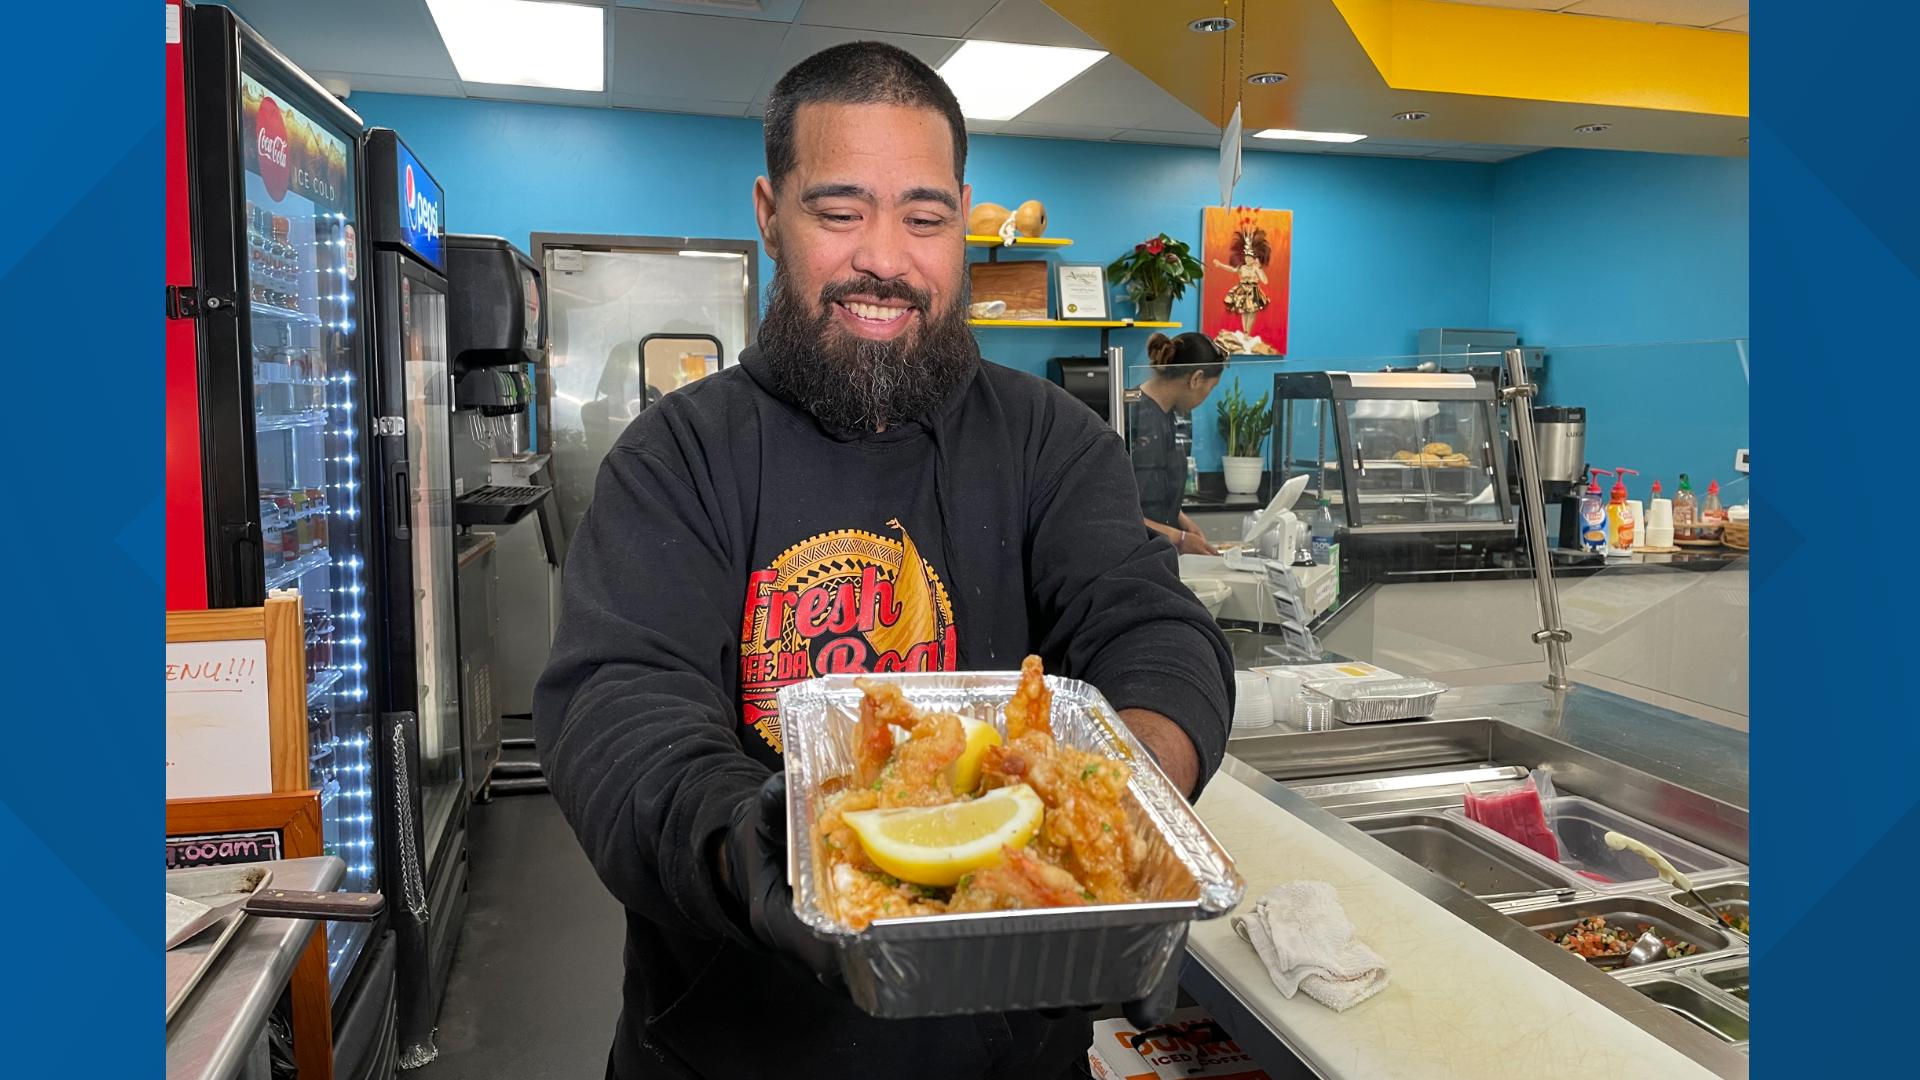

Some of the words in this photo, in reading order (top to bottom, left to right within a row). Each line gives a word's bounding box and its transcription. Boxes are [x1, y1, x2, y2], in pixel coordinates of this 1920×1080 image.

[293, 167, 310, 189] ICE
[313, 177, 335, 201] COLD
[417, 191, 439, 242] pepsi
[743, 566, 902, 641] Fresh
[777, 650, 809, 681] DA
[1151, 1053, 1192, 1066] ICED
